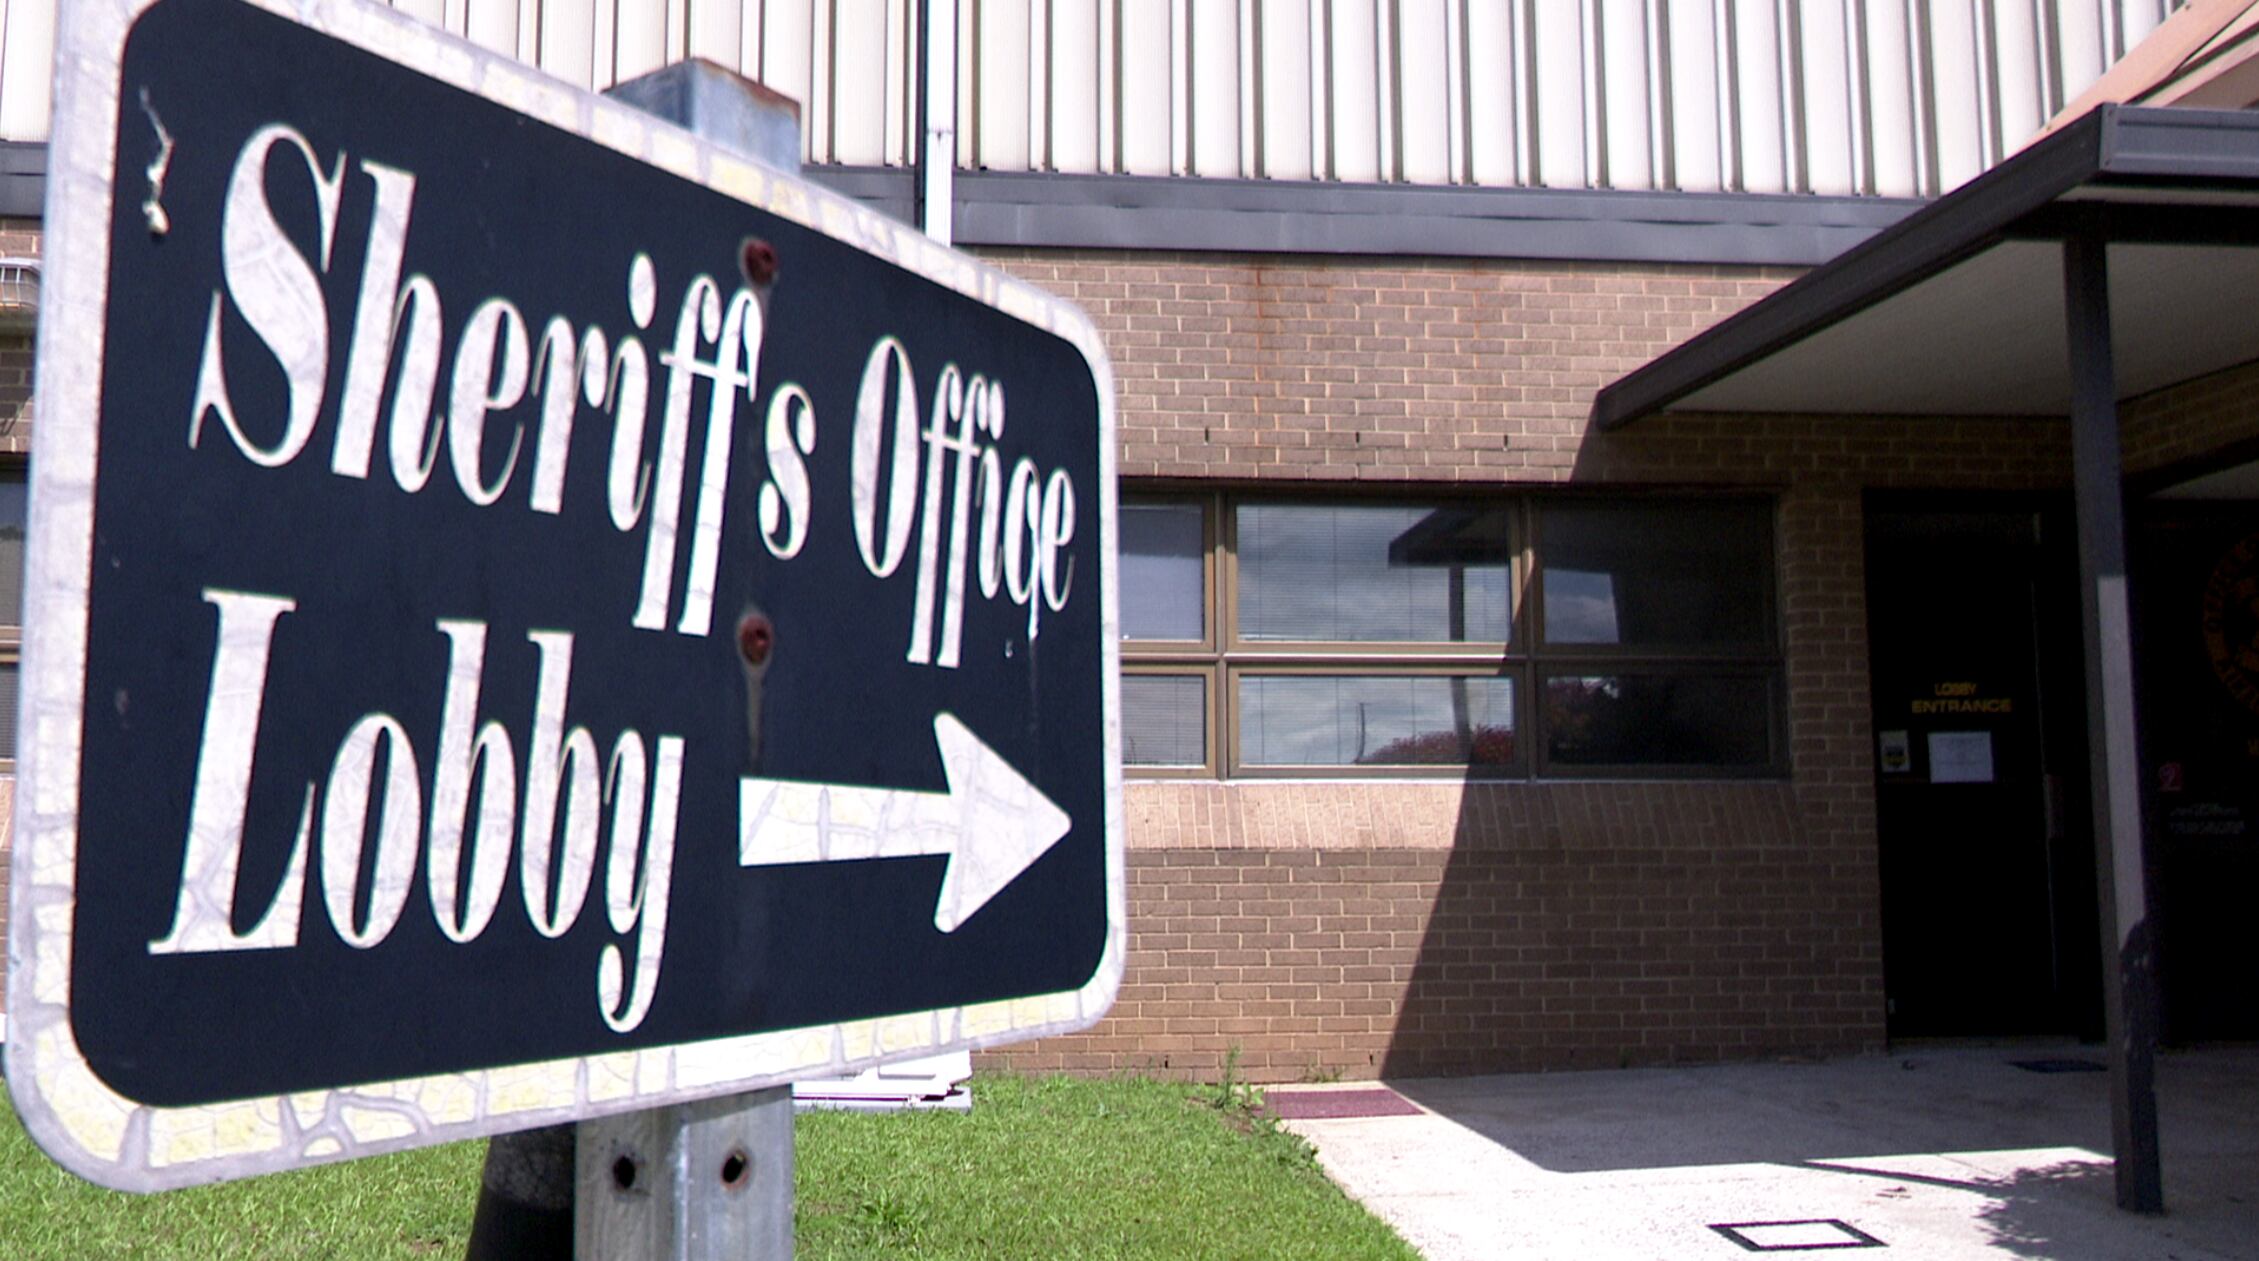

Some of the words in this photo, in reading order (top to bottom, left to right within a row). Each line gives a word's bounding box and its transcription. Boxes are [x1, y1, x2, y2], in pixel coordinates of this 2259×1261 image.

[851, 336, 1076, 668] Office
[1911, 699, 2013, 714] ENTRANCE
[1934, 681, 1978, 697] LOBBY
[148, 587, 686, 1034] Lobby
